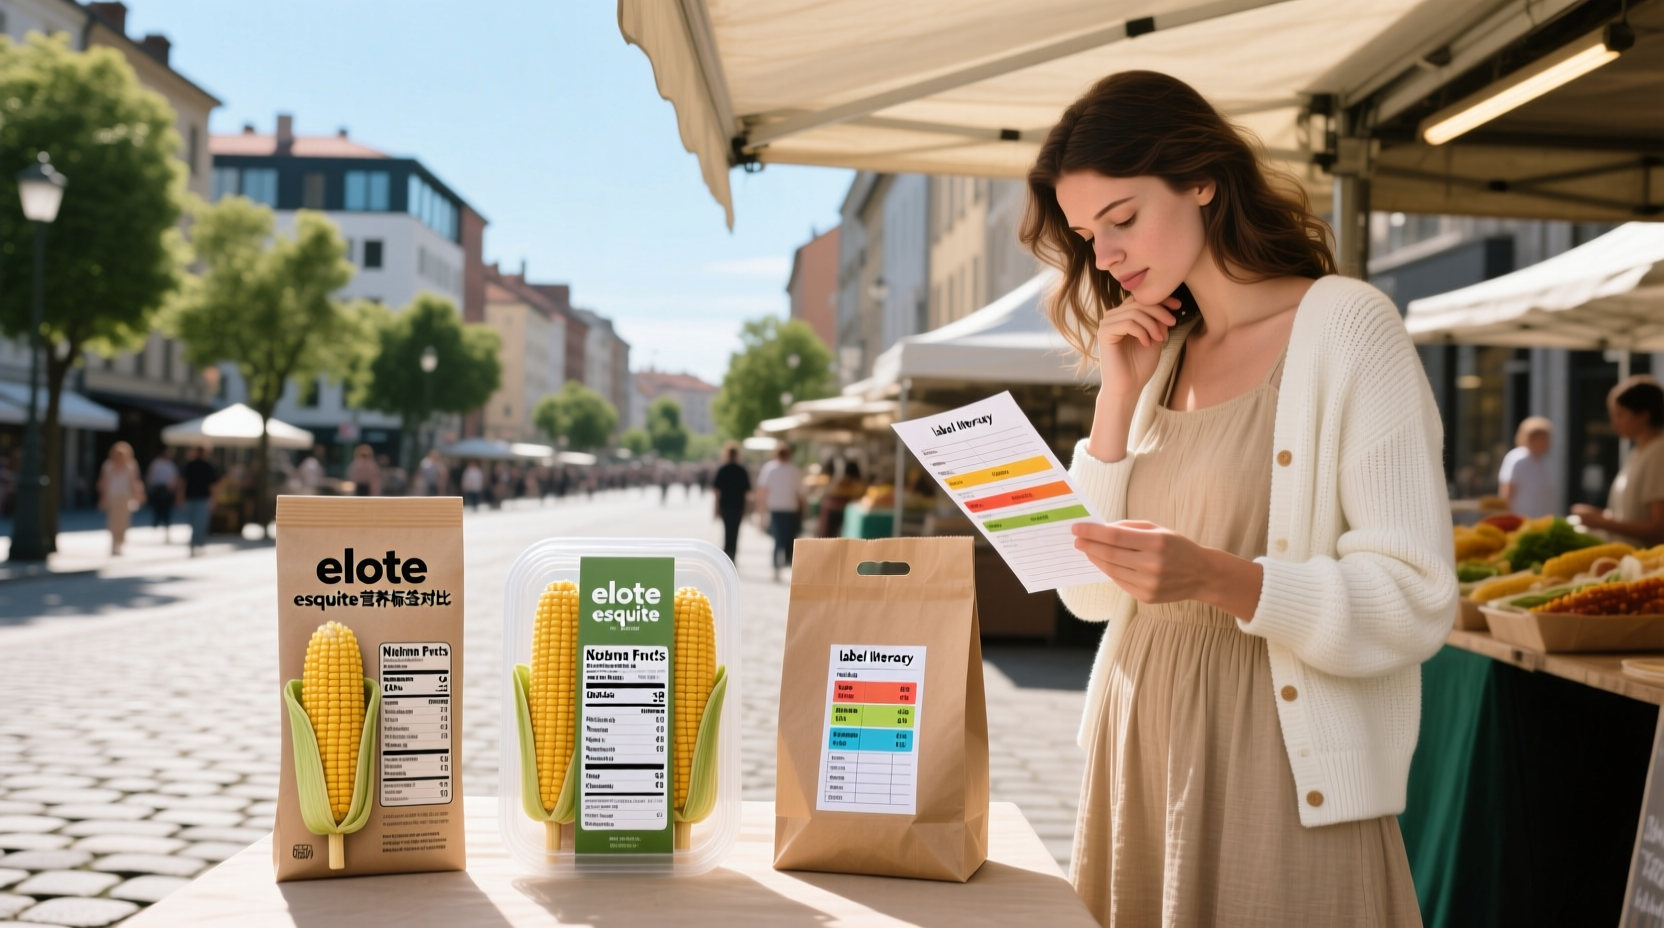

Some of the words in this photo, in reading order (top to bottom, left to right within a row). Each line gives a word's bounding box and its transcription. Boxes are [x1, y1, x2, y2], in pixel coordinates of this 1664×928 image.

[317, 548, 427, 584] elote
[293, 590, 359, 611] esquite
[592, 580, 661, 604] elote
[592, 605, 660, 627] esquite
[839, 649, 867, 662] label
